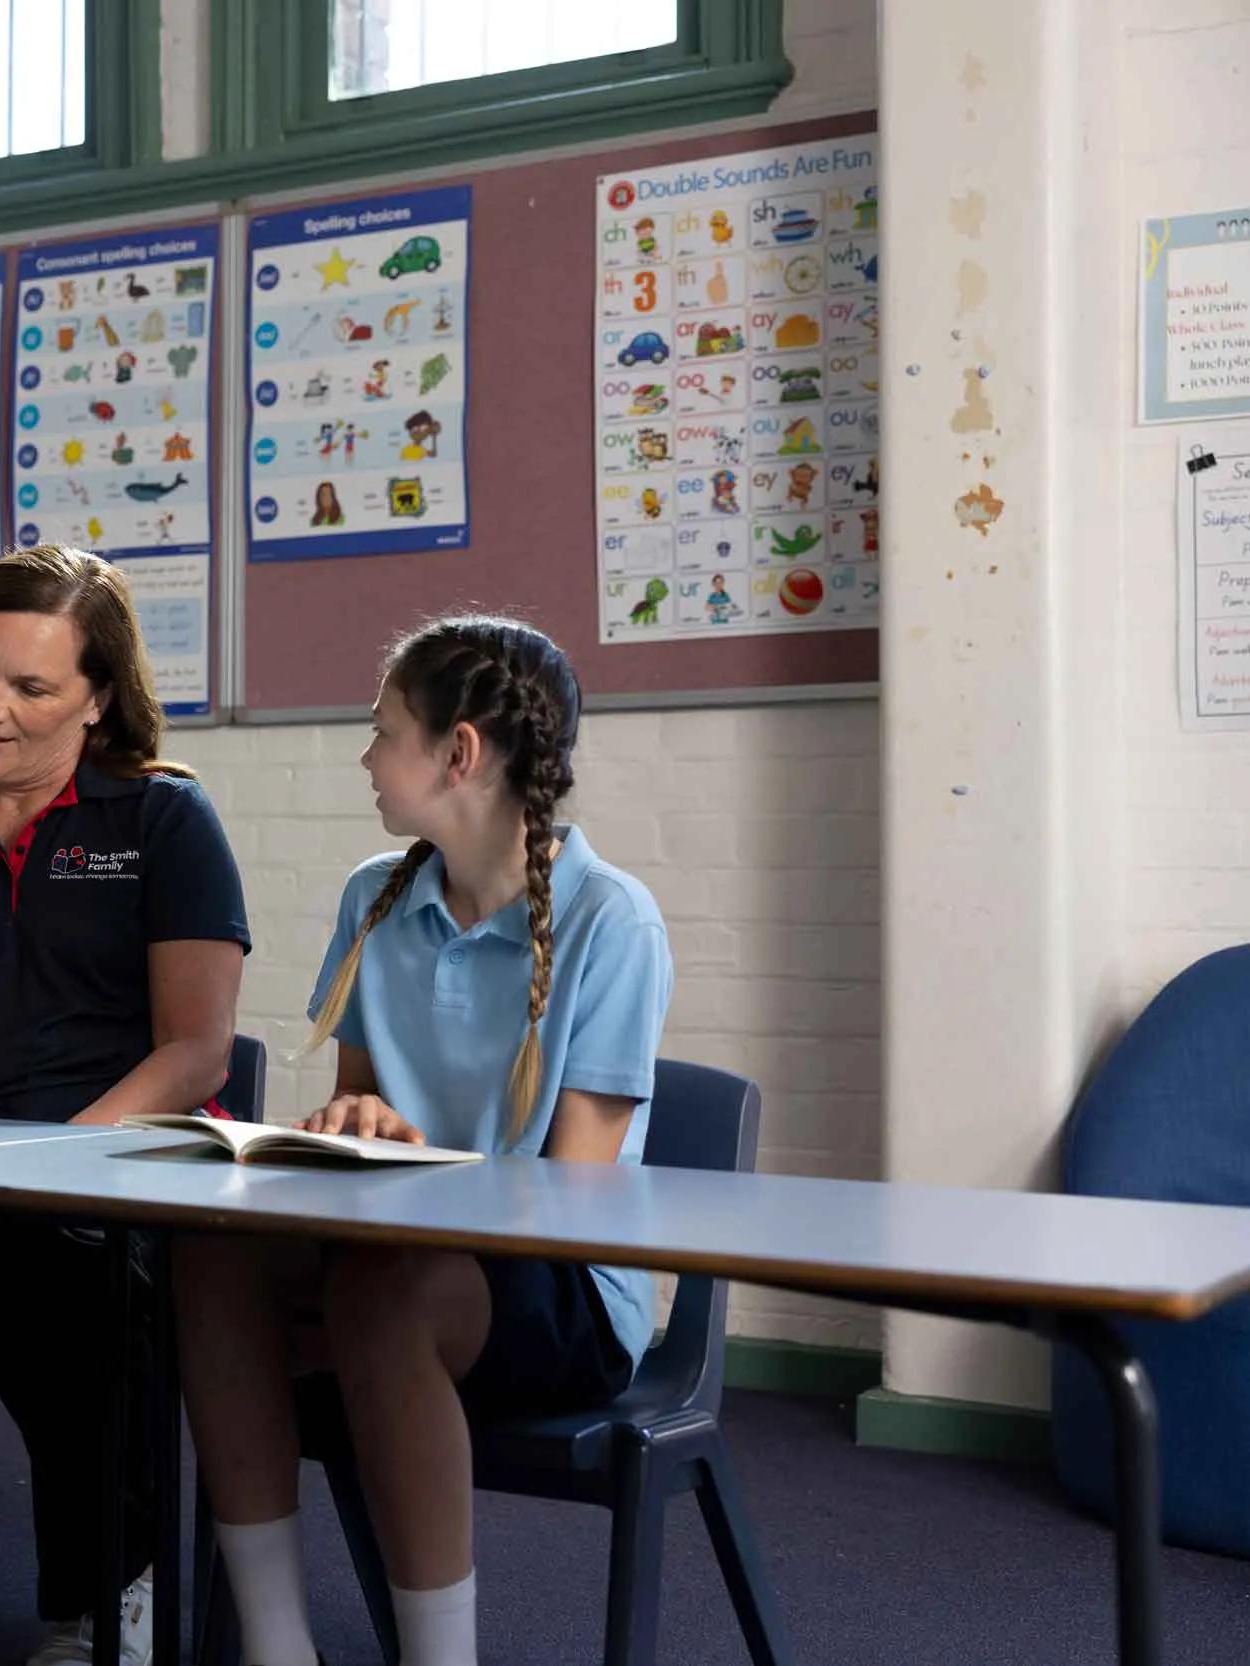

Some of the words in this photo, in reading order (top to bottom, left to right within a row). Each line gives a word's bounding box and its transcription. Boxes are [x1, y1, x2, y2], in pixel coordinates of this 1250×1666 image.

[637, 174, 710, 201] Double
[714, 160, 788, 189] Sounds
[793, 152, 829, 178] Are
[833, 149, 872, 170] Fun
[304, 214, 356, 235] Spelling
[358, 207, 411, 226] choices
[604, 220, 627, 243] ch
[676, 211, 699, 234] ch
[753, 200, 776, 223] sh
[830, 187, 852, 210] sh
[36, 252, 98, 272] Consonant
[101, 245, 147, 264] spelling
[149, 240, 197, 256] choices
[604, 272, 622, 294] th
[633, 271, 656, 313] 3
[677, 265, 696, 286] th
[830, 241, 862, 263] wh
[604, 330, 624, 344] ar
[676, 322, 698, 337] ar
[752, 313, 777, 331] ay
[829, 303, 854, 324] ay
[1166, 320, 1206, 335] Whole
[1209, 319, 1246, 331] Class
[604, 382, 630, 397] oo
[676, 373, 704, 389] oo
[752, 365, 780, 381] oo
[830, 356, 858, 372] oo
[604, 433, 634, 448] ow
[677, 426, 707, 441] ow
[753, 420, 780, 434] ou
[830, 410, 857, 426] ou
[604, 485, 629, 498] ee
[678, 478, 704, 494] ee
[753, 472, 778, 491] ey
[831, 465, 854, 485] ey
[604, 536, 627, 550] er
[677, 529, 700, 544] er
[606, 583, 626, 597] ur
[679, 582, 701, 597] ur
[87, 861, 124, 872] Family
[88, 853, 108, 863] The
[109, 850, 140, 862] Smith
